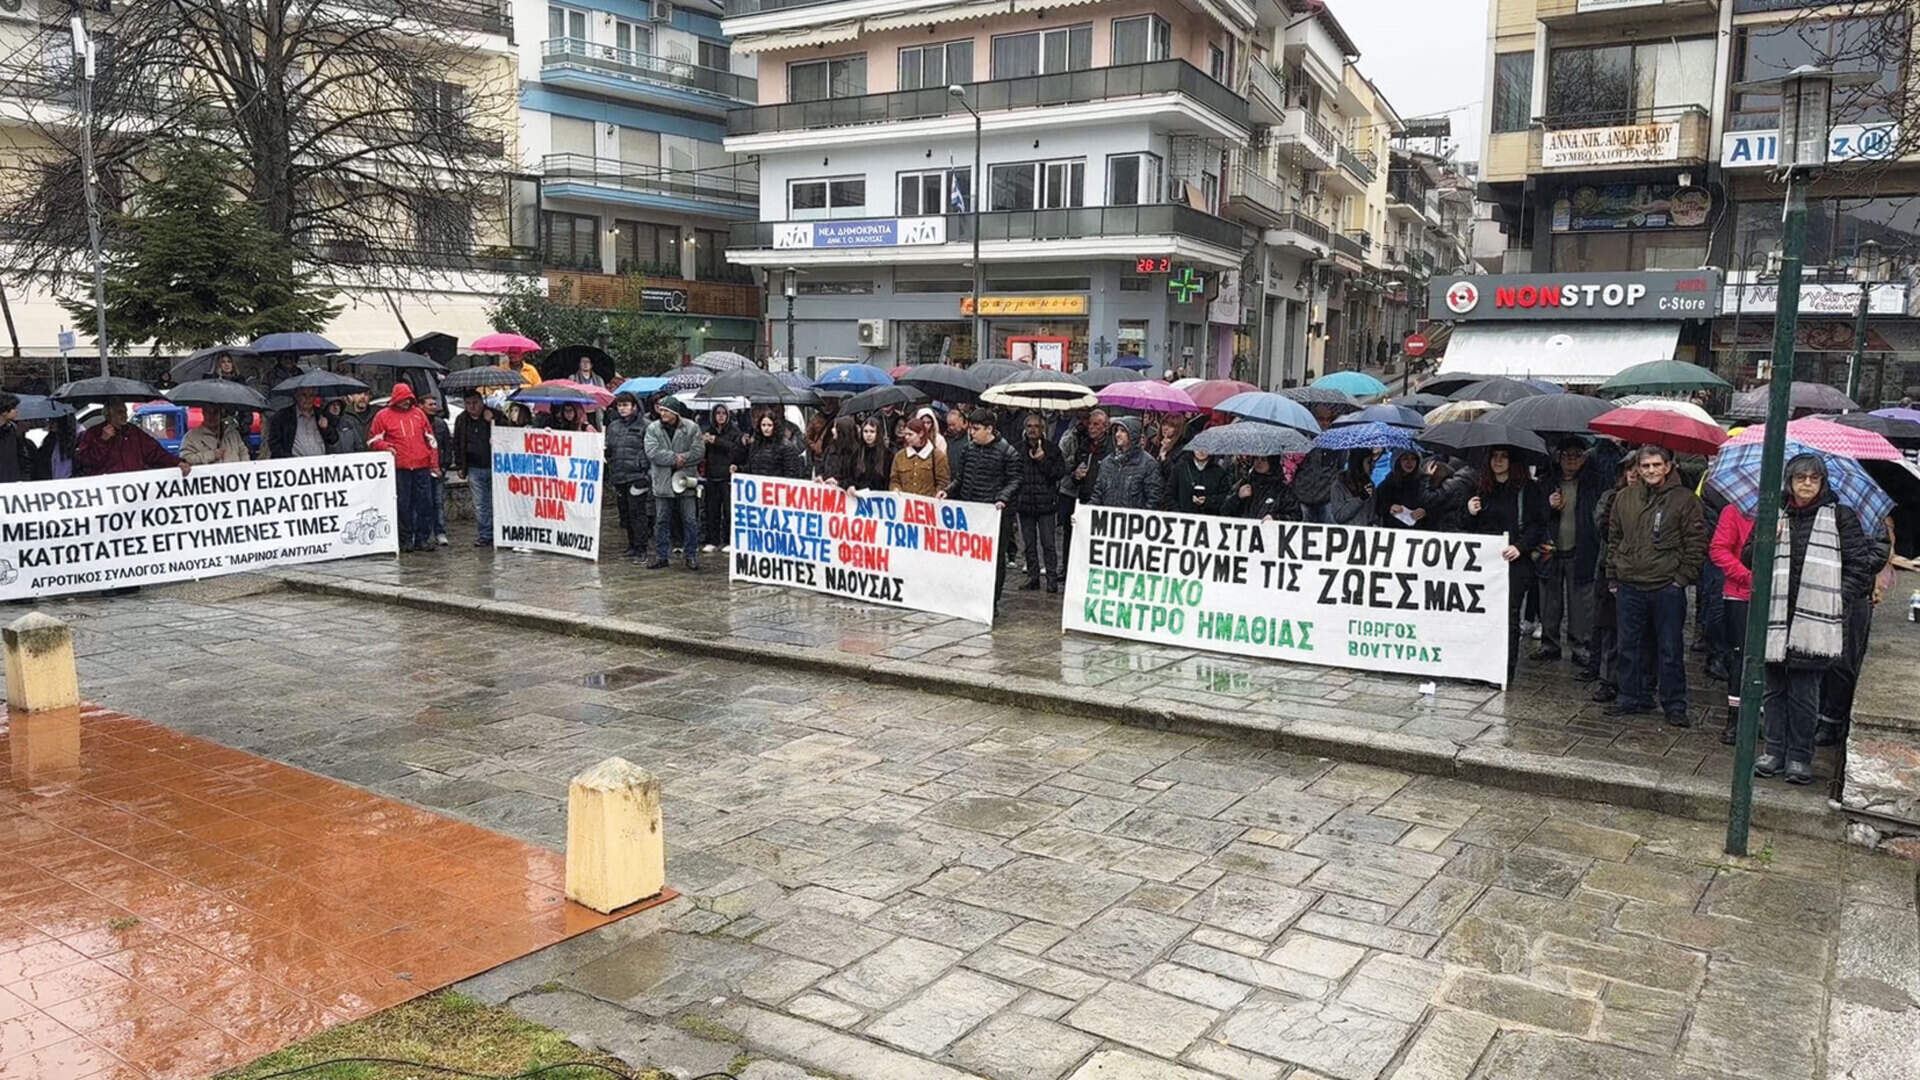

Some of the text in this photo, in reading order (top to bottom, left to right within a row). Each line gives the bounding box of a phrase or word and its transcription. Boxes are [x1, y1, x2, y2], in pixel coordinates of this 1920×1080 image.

[1549, 134, 1578, 150] ΑΝΝΑ
[1555, 147, 1665, 163] ΣΥΜΒΟΛΑΙΟΓΡΑΦΟΣ
[1730, 136, 1849, 162] Allz
[818, 224, 891, 236] ΝΕΑ ΔΗΜΟΚΡΑΤΙΑ
[1137, 258, 1168, 271] 28 2
[1495, 283, 1646, 308] NONSTOP
[1658, 296, 1705, 311] C-Store
[524, 433, 572, 456] ΚΕΡΔΗ
[493, 453, 599, 481] ΒΑΜΜΕΝΑ ΣΤΩΝ
[107, 483, 149, 505] ΤΟΥ
[156, 473, 250, 499] ΧΑΜΕΝΟΥ
[256, 461, 388, 491] ΕΙΣΟΔΗΜΑΤΟΣ
[508, 475, 595, 504] ΦΟΙΤΗΤΩΝ ΤΟ
[3, 490, 349, 542] ΜΕΙΩΣΗ ΤΟΥ ΚΟΣΤΟΥΣ ΠΑΡΑΓΩΓΗΣ
[534, 498, 566, 521] ΑΙΜΑ
[733, 479, 969, 531] ΤΟ ΕΓΚΛΗΜΑ ΑΥΤΟ ΔΕΝ ΘΑ
[18, 515, 340, 568] ΚΑΤΩΤΑΤΕΣ ΕΓΓΥΗΜΕΝΕΣ ΤΙΜΕΣ
[502, 525, 594, 552] ΜΑΘΗΤΕΣ ΝΑΟΥΣΑΣ
[734, 504, 993, 562] ΞΕΧΑΣΤΕΙ ΟΛΩΝ ΤΩΝ ΝΕΚΡΩΝ
[1089, 508, 1483, 572] ΜΠΡΟΣΤΑ ΣΤΑ ΚΕΡΔΗ ΤΟΥΣ
[734, 528, 890, 572] ΓΙΝΟΜΑΣΤΕ ΦΩΝΗ
[31, 543, 333, 589] ΑΓΡΟΤΙΚΟΣ ΣΥΛΛΟΓΟΣ ΝΑΟΥΣΑΣ "ΜΑΡΙΝΟΣ ΑΝΤΥΠΑΣ"
[736, 552, 904, 603] ΜΑΘΗΤΕΣ ΝΑΟΥΣΑΣ
[1088, 539, 1487, 614] ΕΠΙΛΕΓΟΥΜΕ ΤΙΣ ΖΩΕΣ ΜΑΣ
[1087, 568, 1204, 608] ΕΡΓΑΤΙΚΟ
[1083, 597, 1315, 652] ΚΕΝΤΡΟ ΗΜΑΘΙΑΣ
[1347, 618, 1417, 639] ΓΙΩΡΓΟΣ
[1347, 641, 1442, 663] ΒΟΥΤΥΡΑΣ
